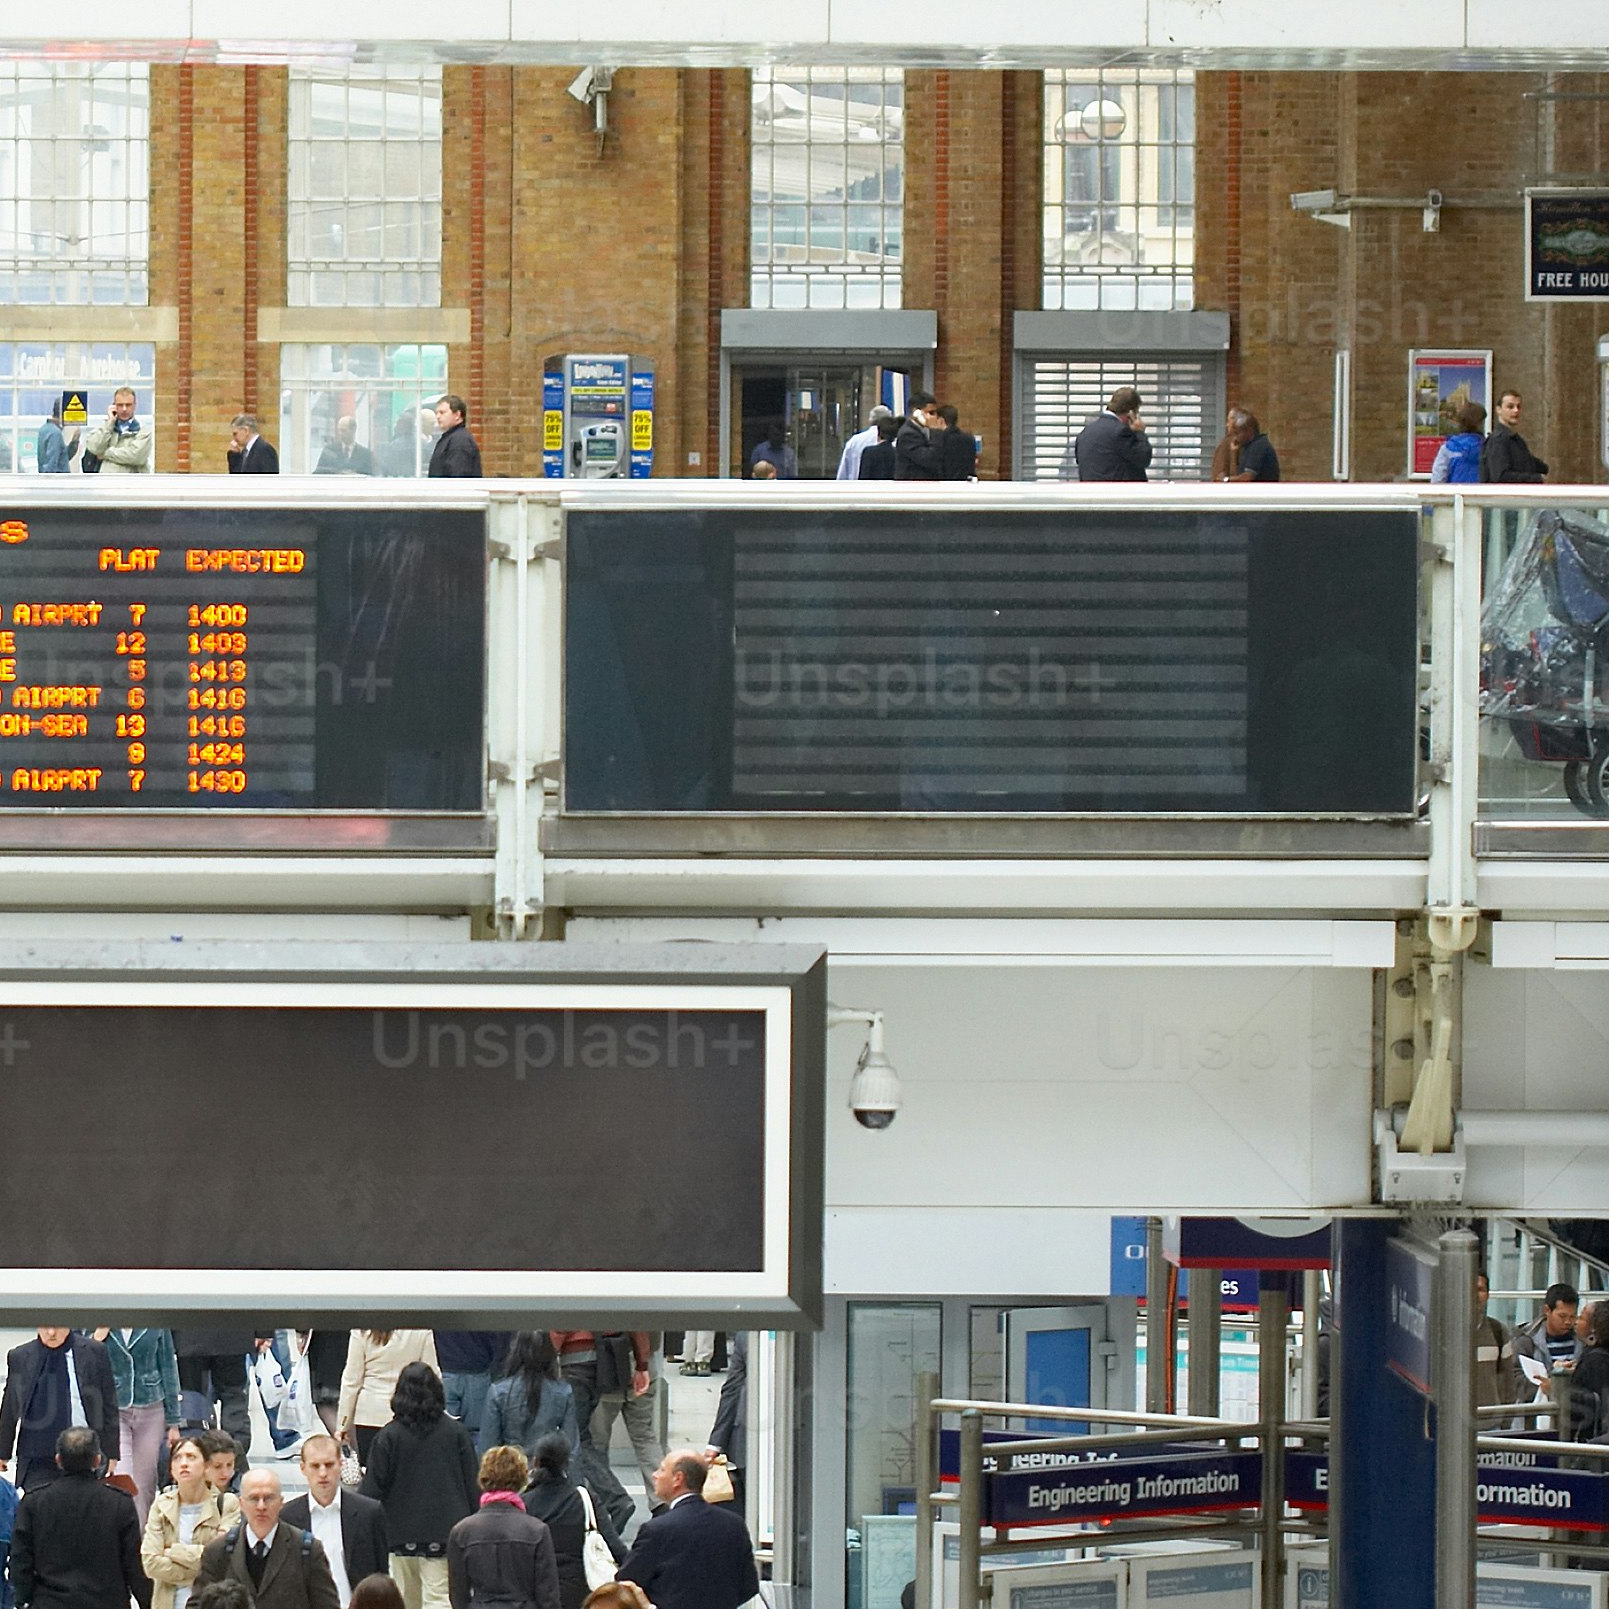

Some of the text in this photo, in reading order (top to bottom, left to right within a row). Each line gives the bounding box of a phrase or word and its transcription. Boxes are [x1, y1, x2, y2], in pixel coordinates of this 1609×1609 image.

[1537, 273, 1609, 287] FREE HOU
[634, 414, 650, 423] 75%
[635, 425, 649, 433] OFF
[98, 547, 160, 572] PLAT
[185, 548, 304, 574] EXPECTED
[128, 603, 146, 627] 7
[188, 603, 248, 628] 1400
[115, 631, 146, 656] 12
[1028, 1470, 1240, 1511] Engineering Information
[1476, 1483, 1572, 1509] ormation
